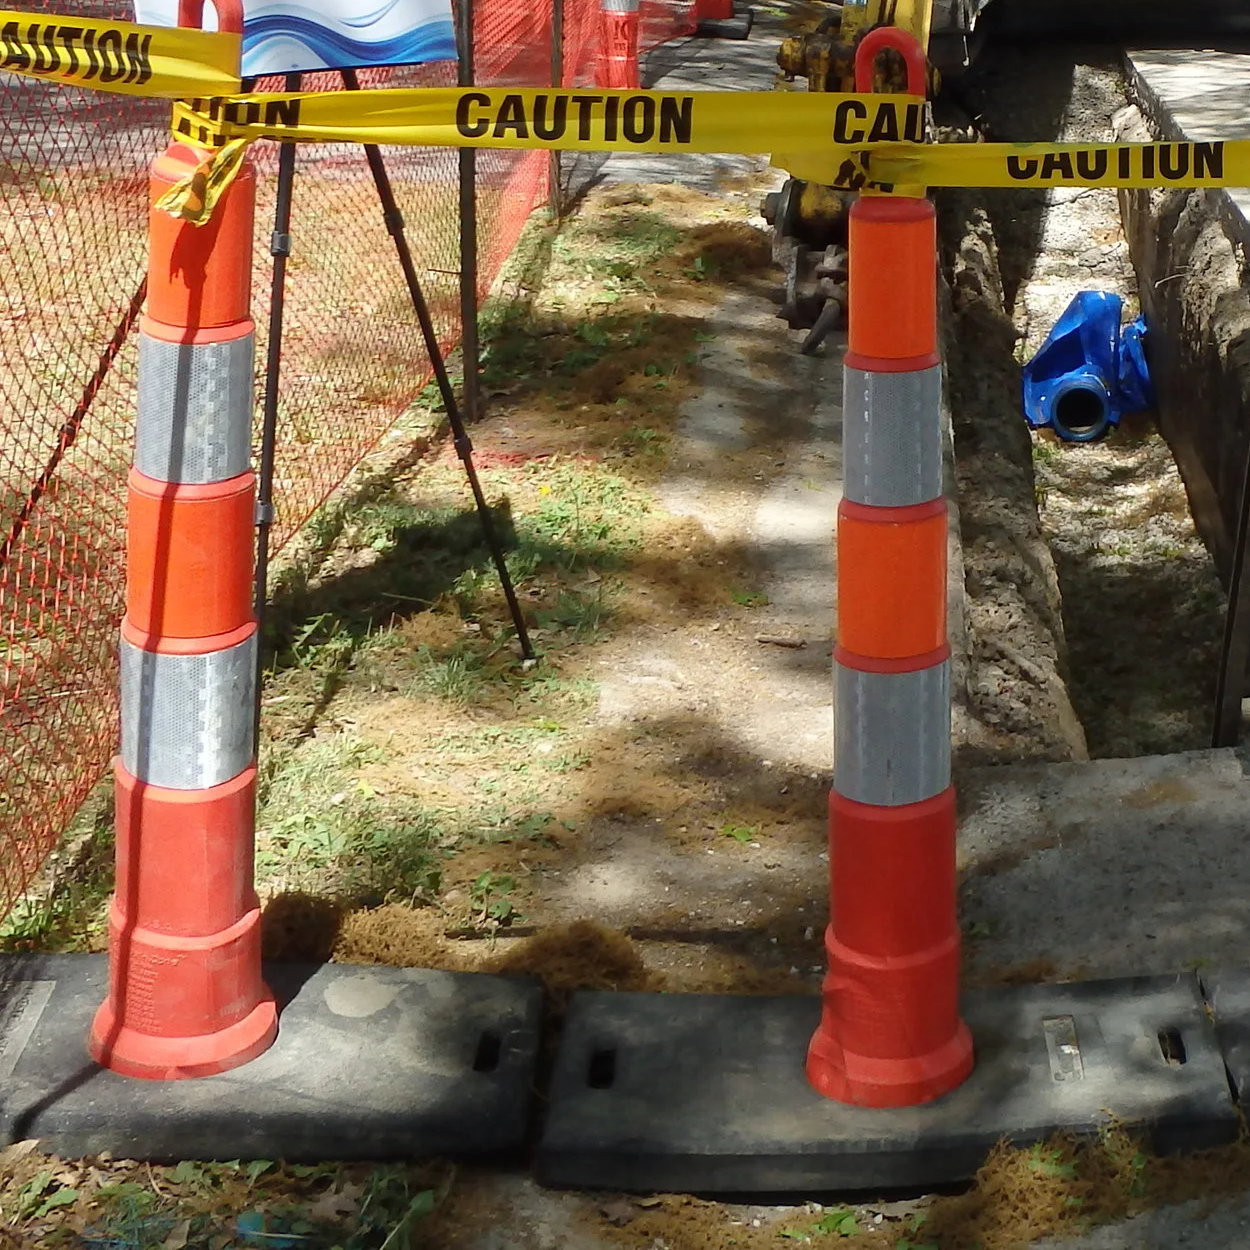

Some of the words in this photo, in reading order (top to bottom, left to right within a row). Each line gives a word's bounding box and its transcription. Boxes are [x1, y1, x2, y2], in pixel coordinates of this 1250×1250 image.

[0, 21, 153, 85] AUTION
[456, 92, 694, 144] CAUTION
[833, 100, 926, 144] CAU
[1006, 140, 1224, 180] CAUTION
